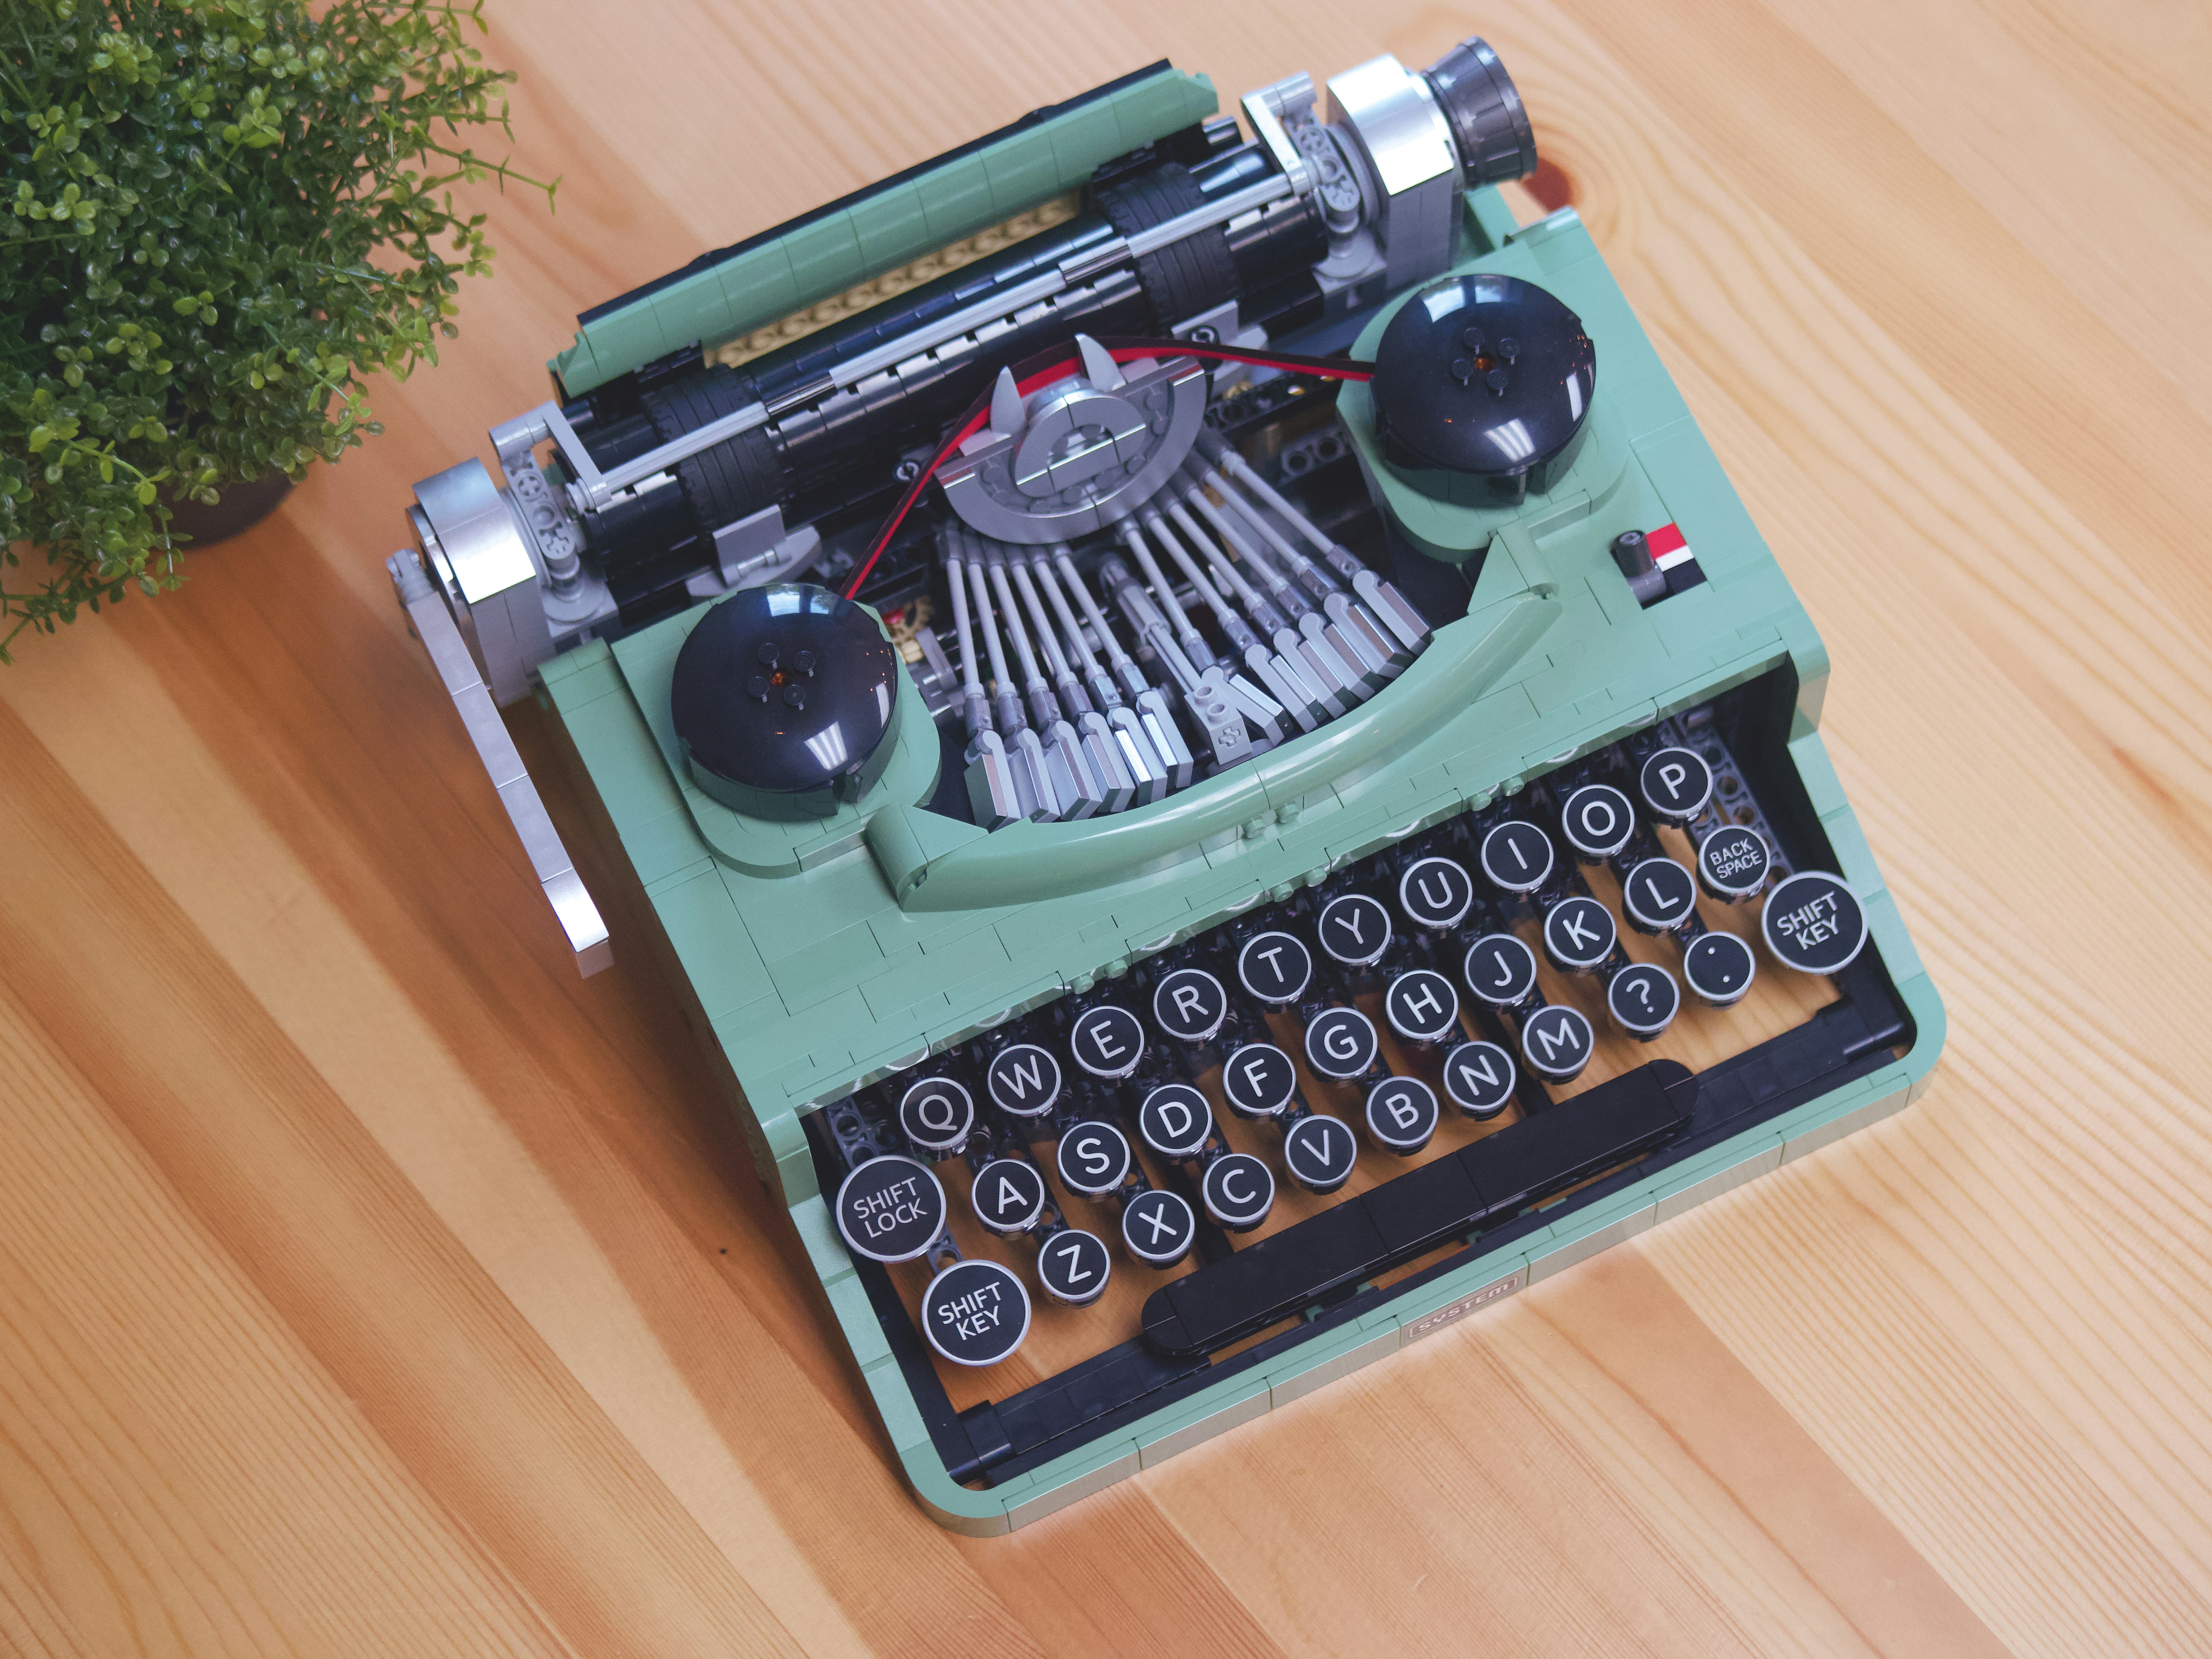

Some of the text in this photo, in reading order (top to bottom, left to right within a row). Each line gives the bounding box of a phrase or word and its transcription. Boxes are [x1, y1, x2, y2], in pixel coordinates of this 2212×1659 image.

[1659, 764, 1685, 799] P
[1582, 801, 1615, 836] O
[1508, 838, 1527, 869] I
[1710, 838, 1754, 866] BACK
[1716, 851, 1762, 879] SPACE
[1418, 872, 1452, 908] U
[1646, 878, 1679, 909] L
[1335, 908, 1363, 944] Y
[1563, 911, 1600, 950] K
[1776, 892, 1838, 937] SHIFT
[1796, 918, 1839, 951] KEY
[1257, 947, 1284, 982] T
[1494, 951, 1512, 986] J
[1708, 947, 1729, 982] :
[1172, 986, 1208, 1023] R
[1403, 984, 1442, 1024] H
[1626, 979, 1653, 1013] ?
[1090, 1021, 1125, 1059] E
[1324, 1025, 1358, 1059] G
[1538, 1017, 1581, 1060] M
[998, 1055, 1042, 1099] W
[1244, 1059, 1267, 1097] F
[1459, 1055, 1499, 1095] N
[919, 1095, 957, 1130] Q
[1158, 1102, 1192, 1138] D
[1385, 1094, 1418, 1129] B
[1077, 1138, 1109, 1174] S
[1301, 1129, 1330, 1166] V
[853, 1176, 918, 1220] SHIFT
[998, 1177, 1027, 1214] A
[1222, 1169, 1256, 1203] C
[864, 1198, 928, 1238] LOCK
[1138, 1203, 1177, 1244] X
[1057, 1245, 1091, 1283] Z
[938, 1281, 1003, 1325] SHIFT
[955, 1306, 1001, 1341] KEY
